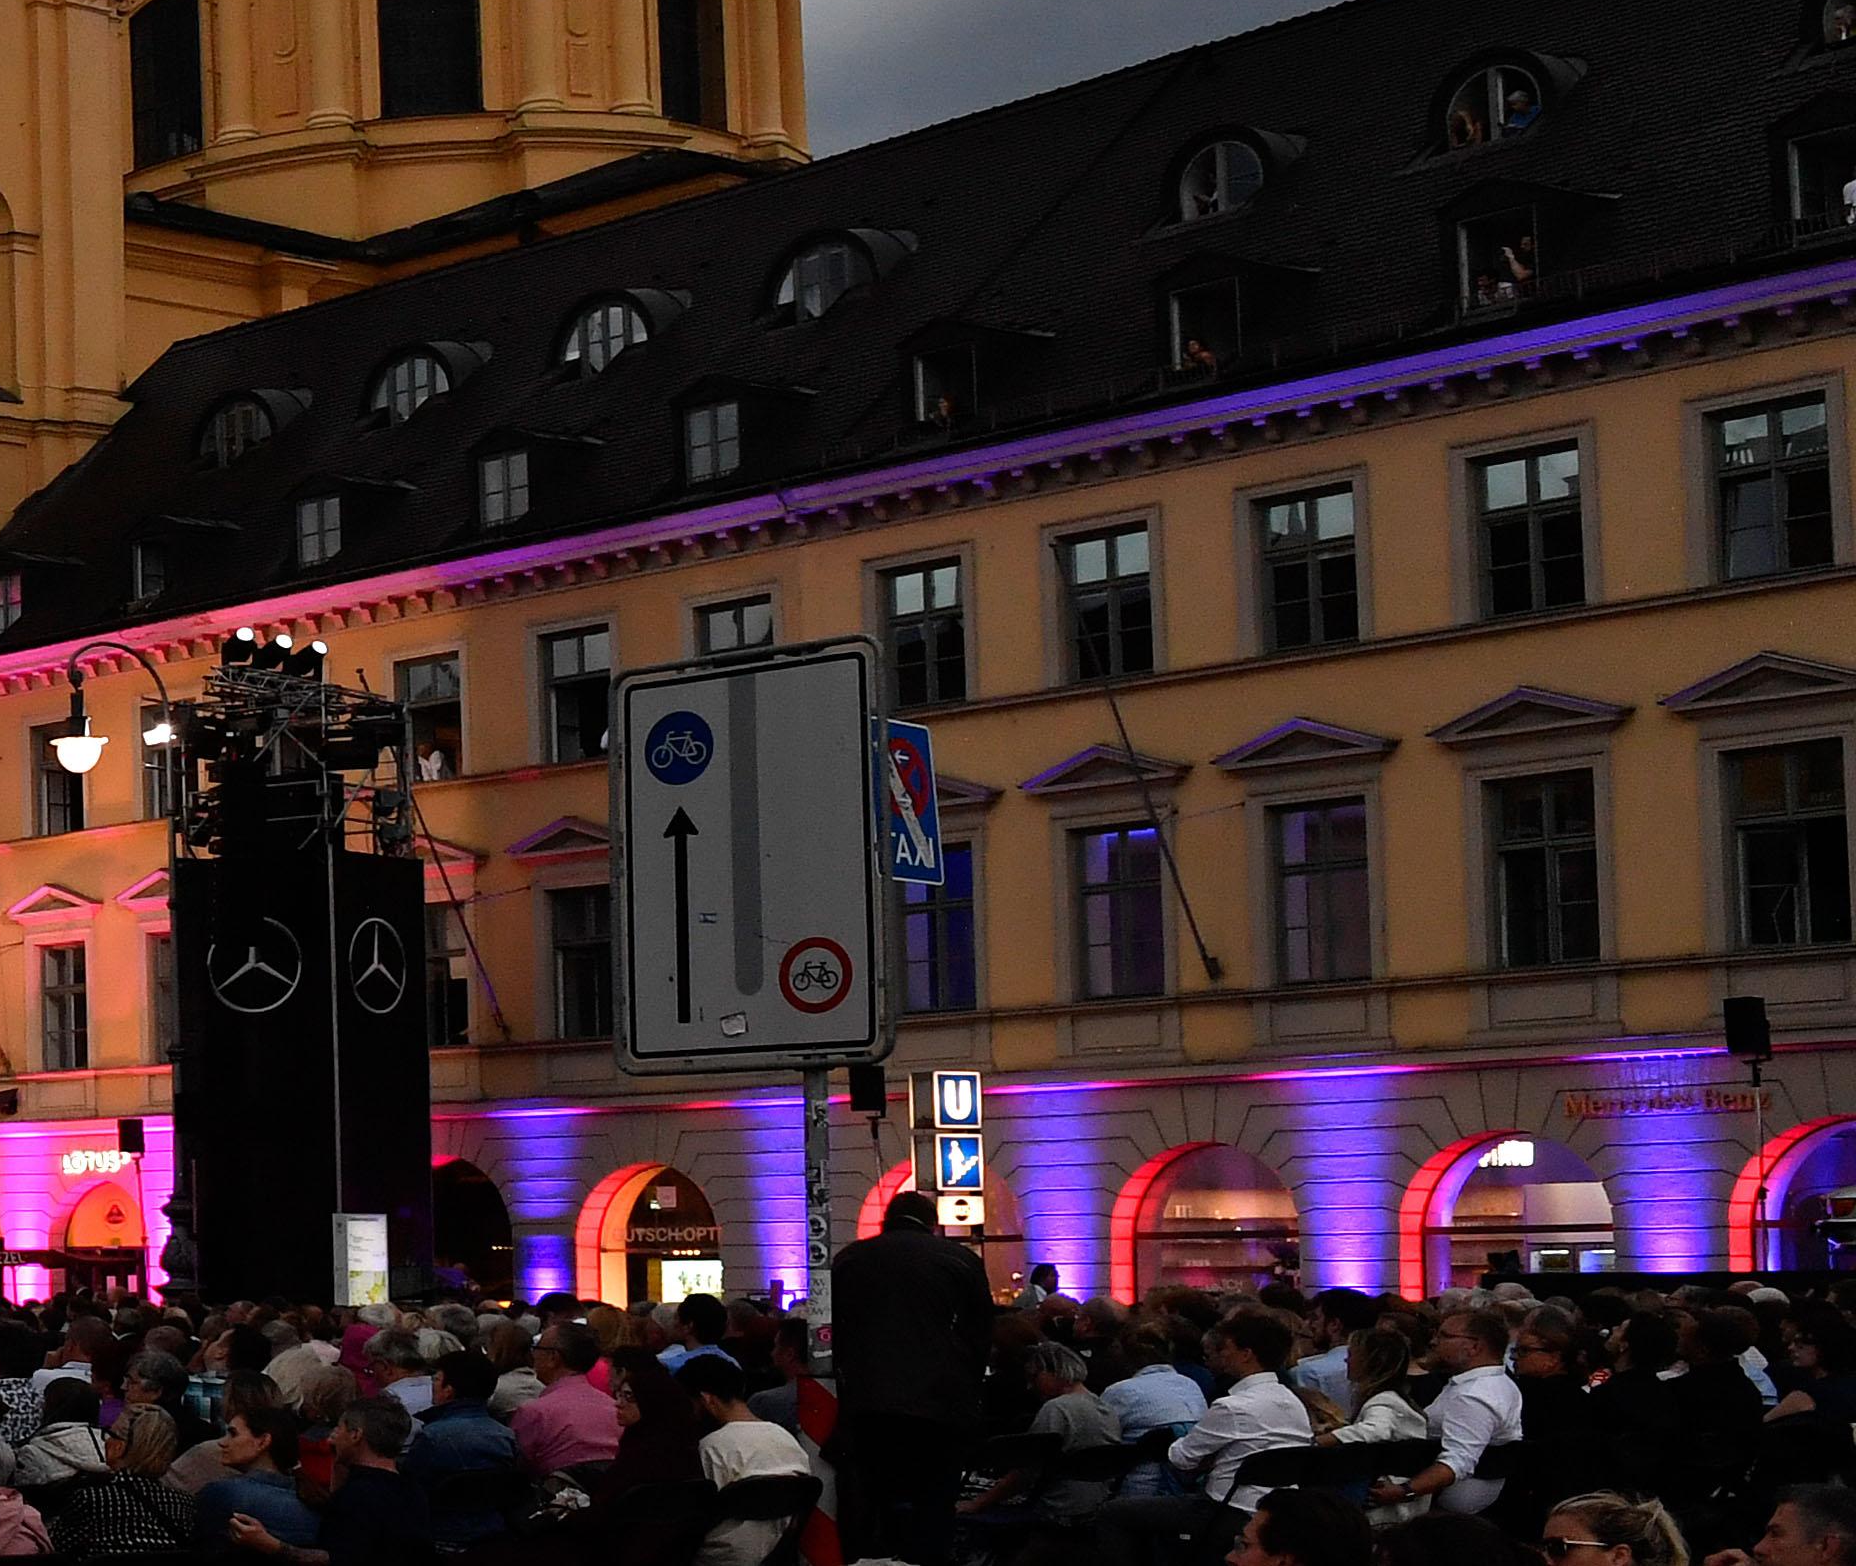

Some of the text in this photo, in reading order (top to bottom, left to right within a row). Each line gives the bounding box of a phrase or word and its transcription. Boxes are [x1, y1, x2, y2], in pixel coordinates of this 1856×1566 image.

[890, 831, 936, 869] AXI
[943, 1079, 973, 1121] U
[62, 1149, 122, 1174] LOTUS
